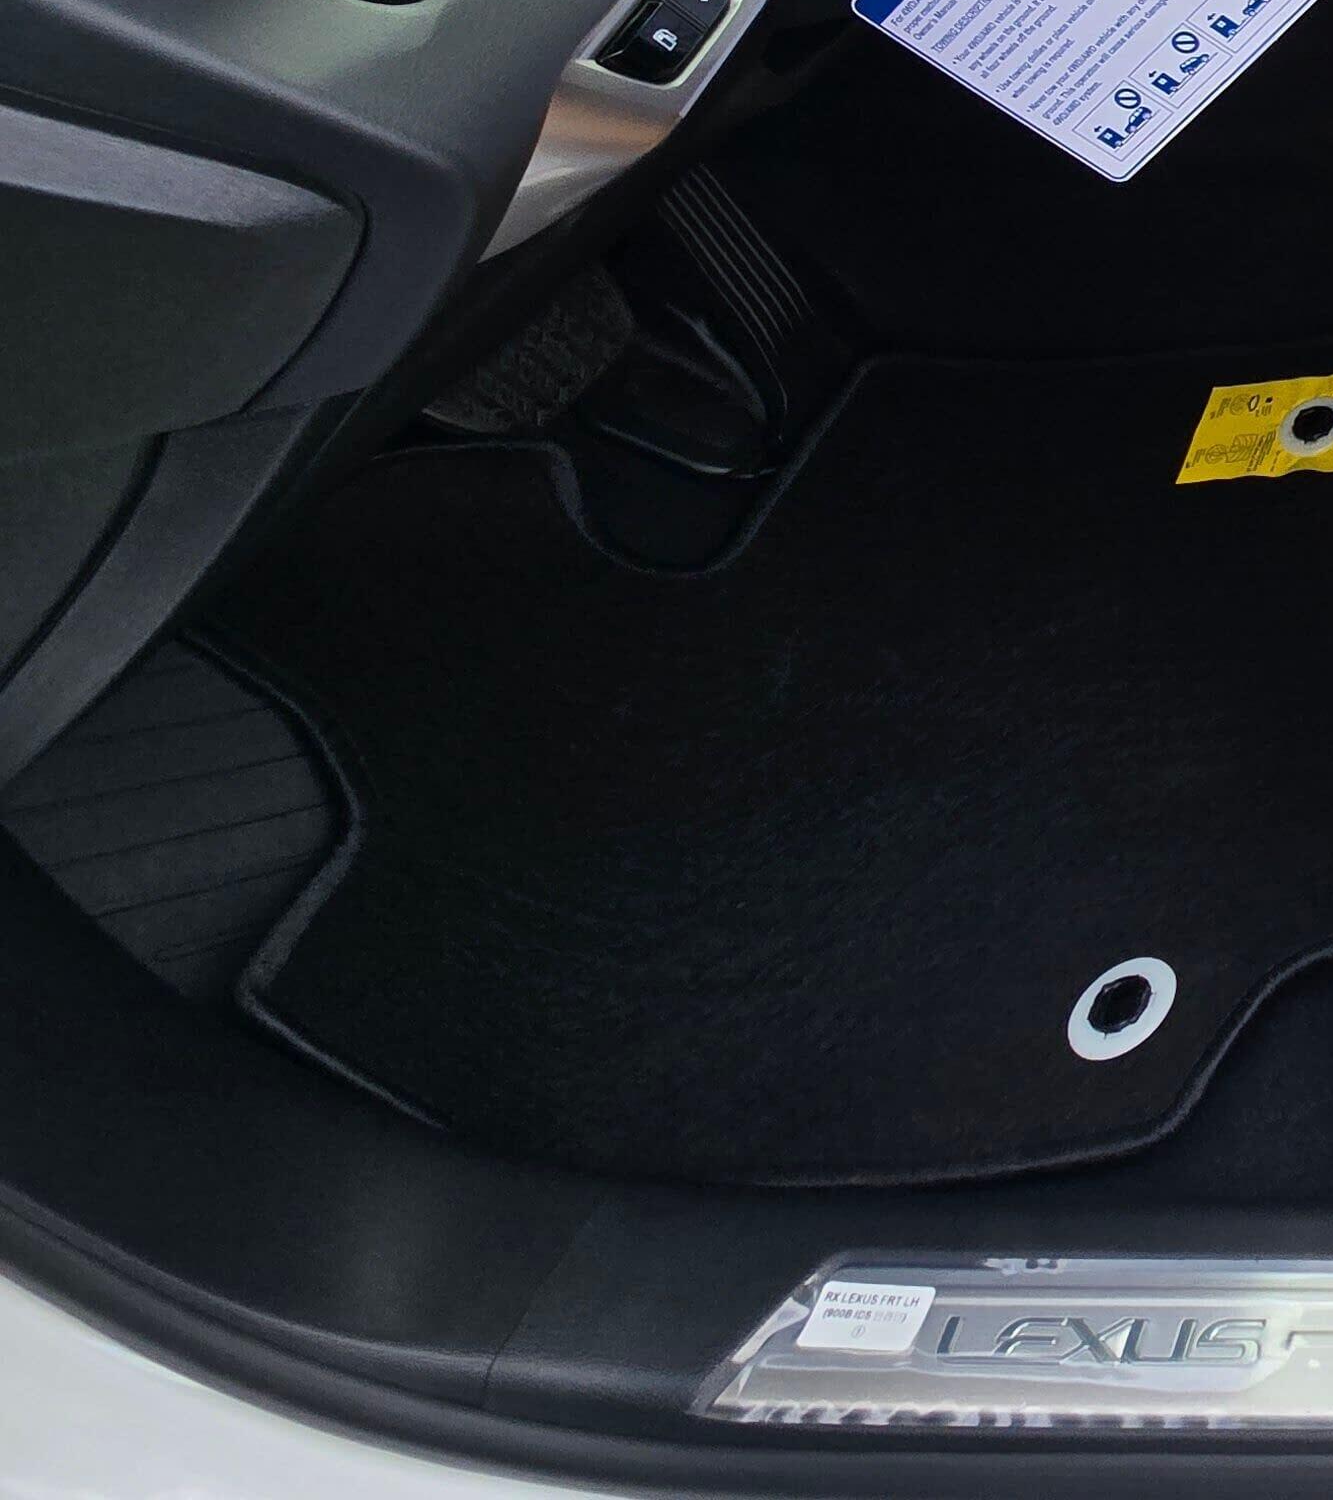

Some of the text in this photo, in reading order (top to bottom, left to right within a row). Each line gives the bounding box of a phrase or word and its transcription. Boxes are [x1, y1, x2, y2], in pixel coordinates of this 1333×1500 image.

[1112, 13, 1129, 27] with
[824, 1291, 920, 1308] RX LEXUS FRT LH
[936, 1315, 1277, 1367] LEXUS
